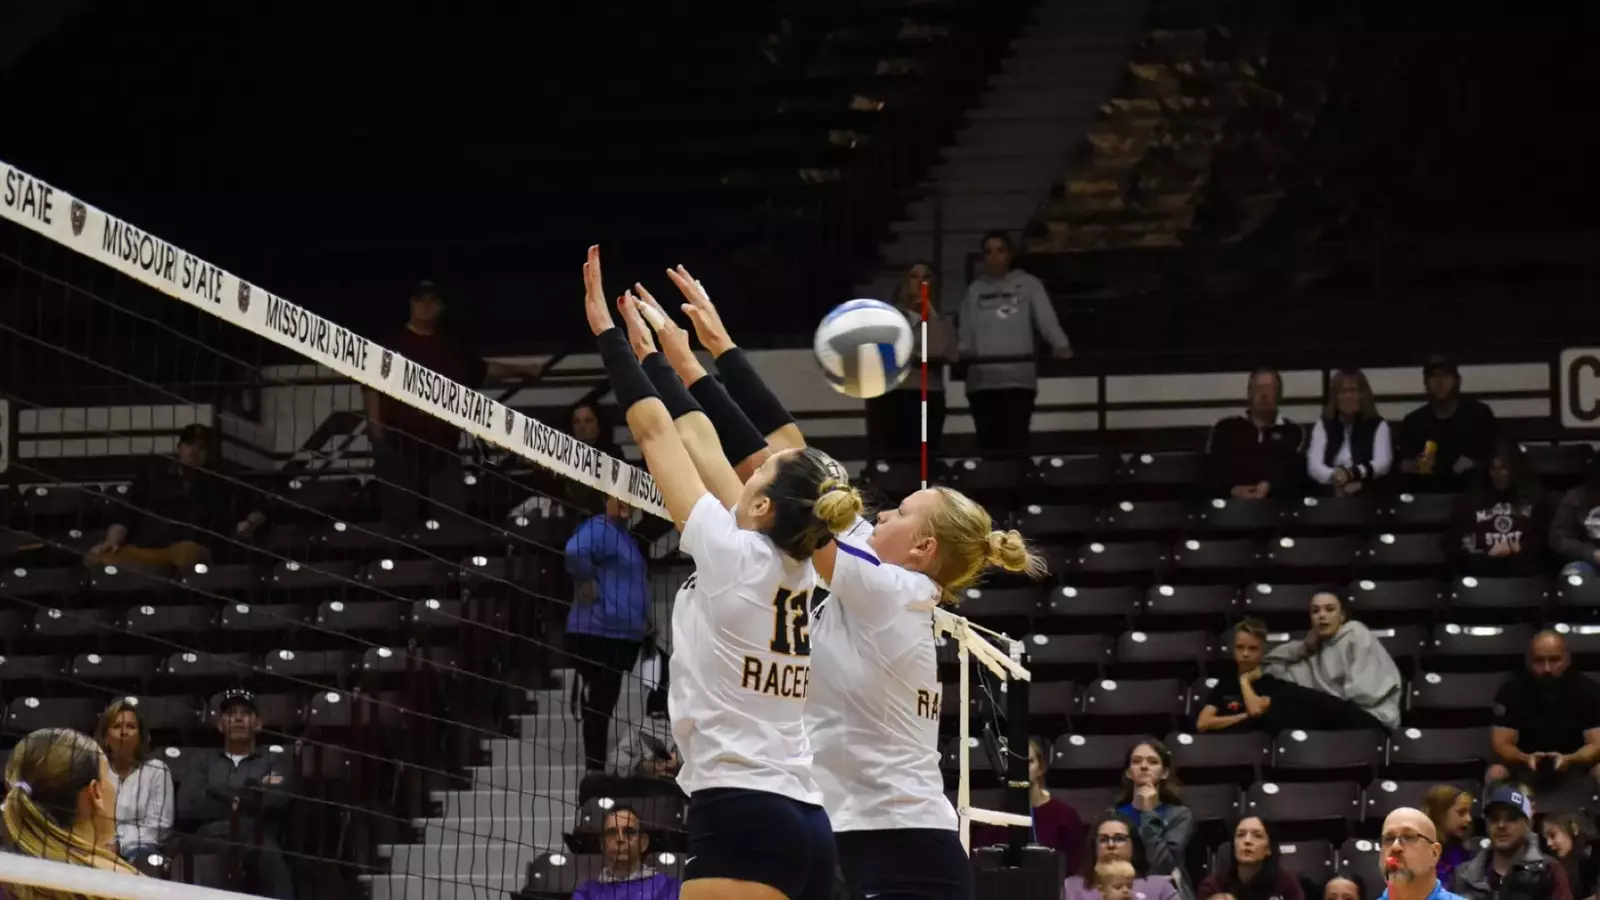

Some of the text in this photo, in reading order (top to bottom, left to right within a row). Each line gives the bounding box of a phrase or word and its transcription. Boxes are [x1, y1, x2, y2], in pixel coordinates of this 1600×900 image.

[4, 169, 53, 225] STATE
[102, 215, 224, 304] MISSOURI STATE
[265, 293, 370, 371] MISSOURI STATE
[402, 359, 495, 429] MISSOURI STATE
[1568, 355, 1600, 423] C
[522, 417, 602, 479] MISSOURI STATE
[628, 466, 668, 508] MISSOU
[770, 586, 810, 657] 12
